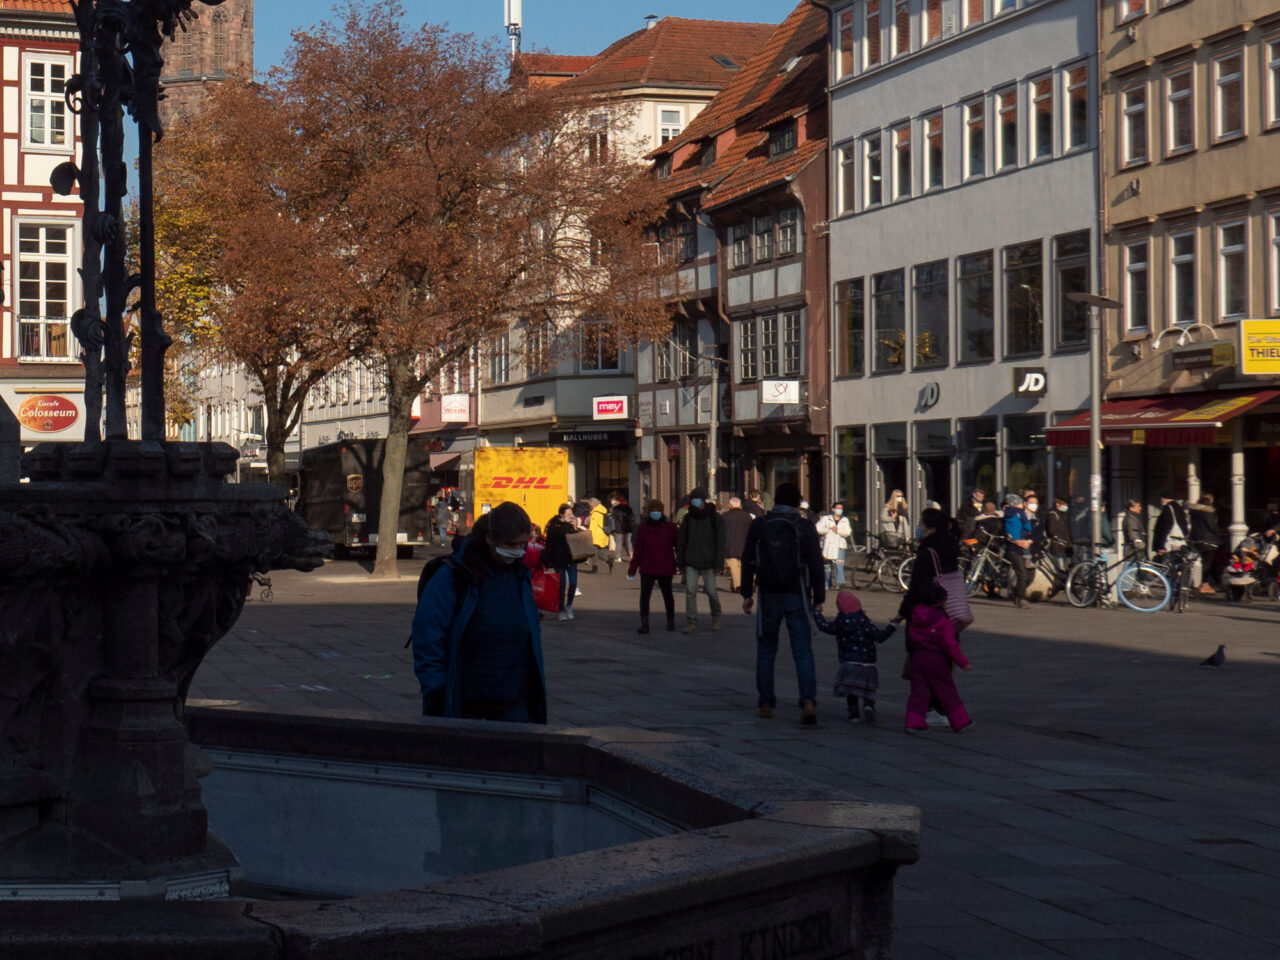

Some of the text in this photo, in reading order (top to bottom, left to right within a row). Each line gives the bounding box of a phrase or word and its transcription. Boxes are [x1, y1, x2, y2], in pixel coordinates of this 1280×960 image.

[1018, 373, 1045, 392] JD
[921, 381, 940, 407] JD
[20, 407, 76, 417] Colosseum
[599, 403, 622, 413] mey
[491, 477, 551, 489] DHL
